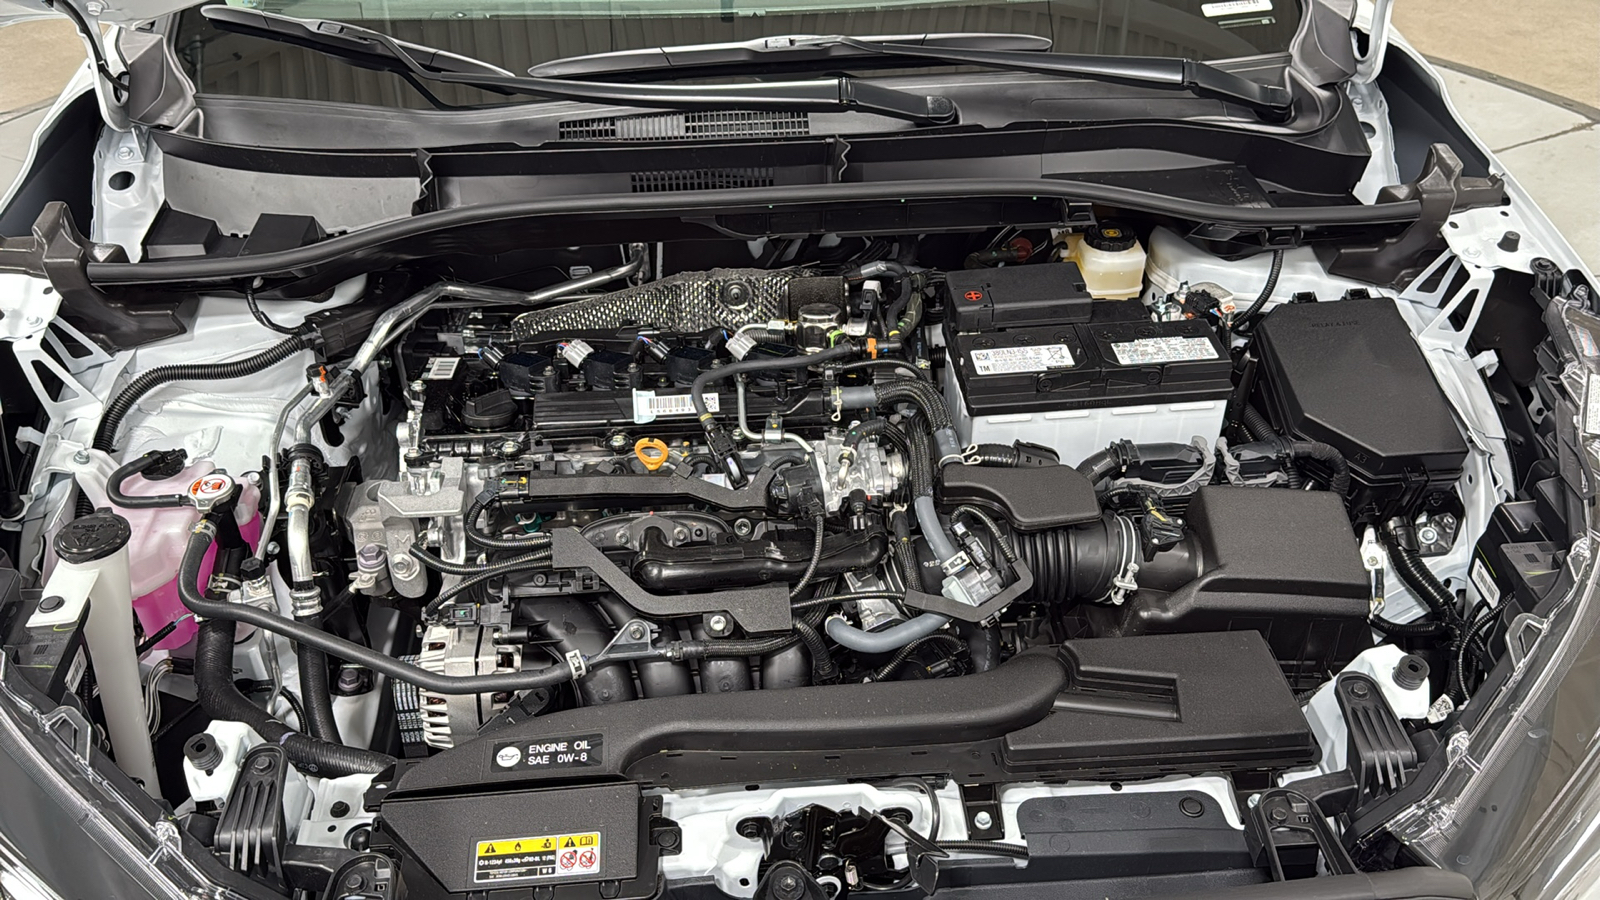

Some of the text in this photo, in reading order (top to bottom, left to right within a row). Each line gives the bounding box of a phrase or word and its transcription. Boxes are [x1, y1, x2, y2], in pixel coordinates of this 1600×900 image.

[979, 365, 991, 373] TM
[529, 740, 592, 754] ENGINE OIL
[527, 752, 588, 766] SAE 0W-8
